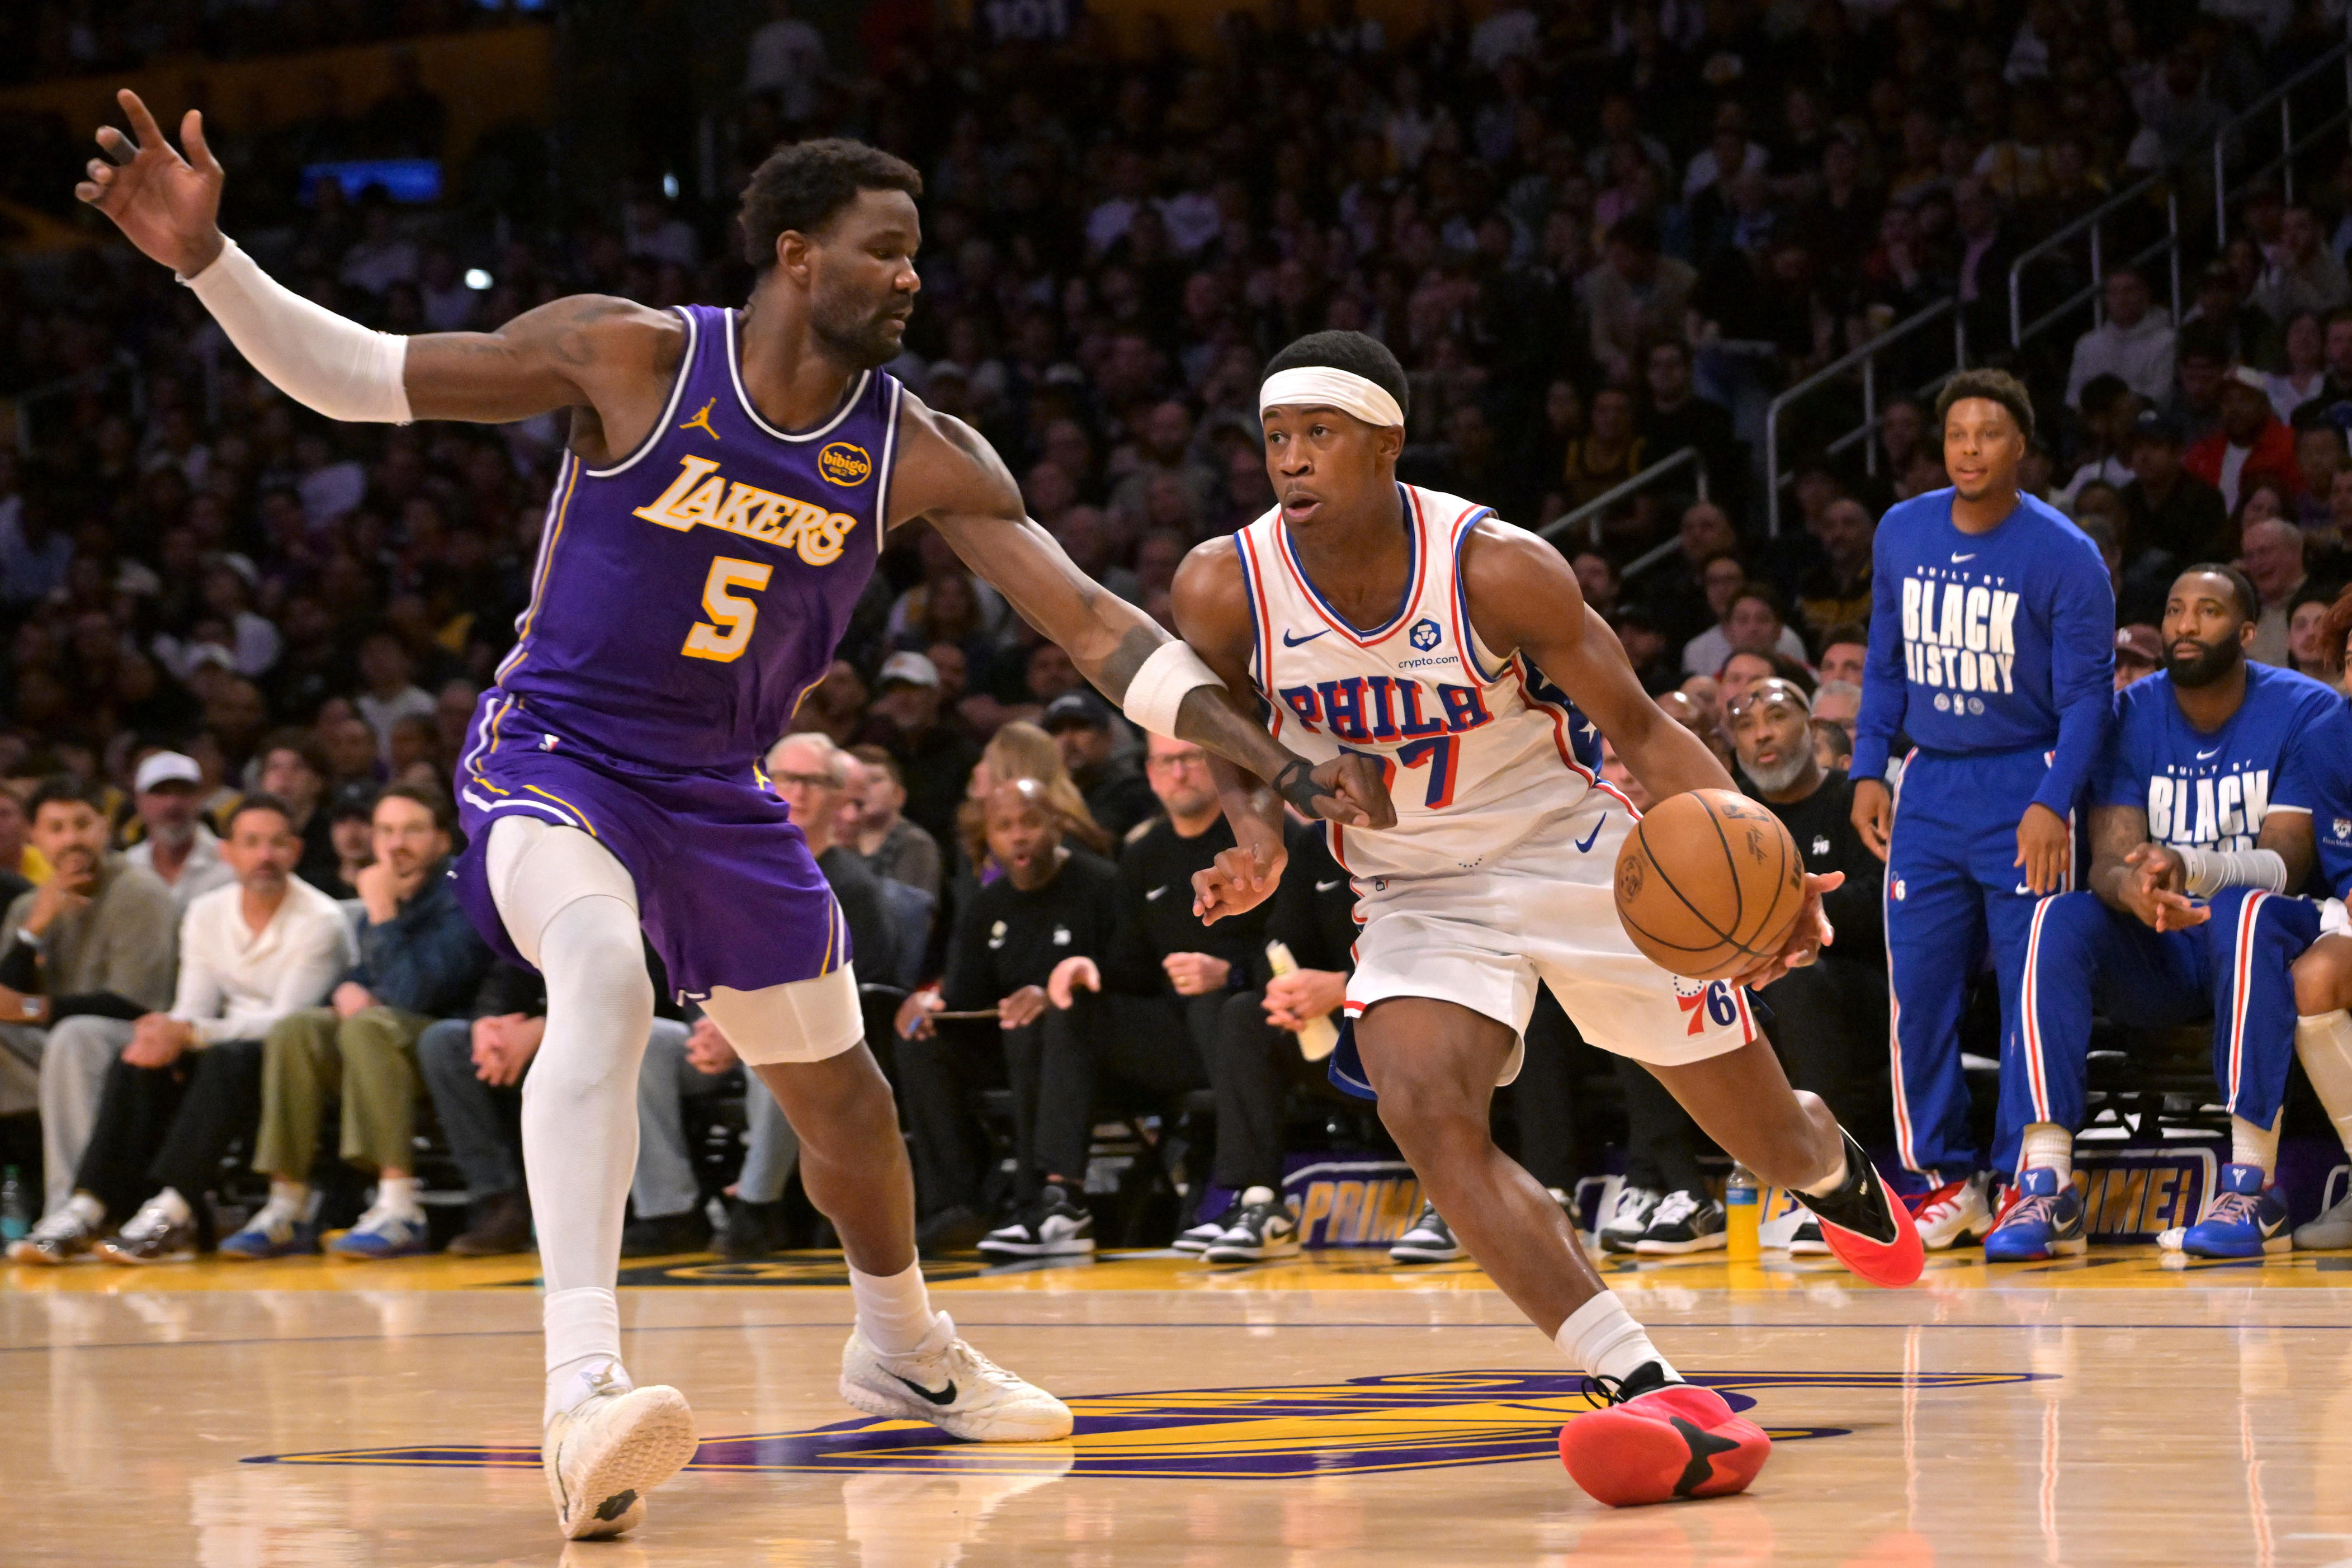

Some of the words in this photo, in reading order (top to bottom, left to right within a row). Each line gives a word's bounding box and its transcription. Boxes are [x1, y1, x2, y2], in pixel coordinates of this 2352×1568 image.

[823, 451, 867, 476] bibigo
[632, 454, 857, 566] LAKERS
[1917, 565, 1970, 583] BUILT
[1983, 574, 2005, 587] BY
[681, 555, 773, 663] 5
[1902, 577, 2019, 656] BLACK
[1399, 656, 1458, 669] crypto.com
[1904, 641, 2014, 694] HISTORY
[1279, 676, 1494, 744] PHILA
[2167, 764, 2218, 777] BUILT
[2148, 769, 2269, 843] BLACK
[1676, 980, 1736, 1036] 76
